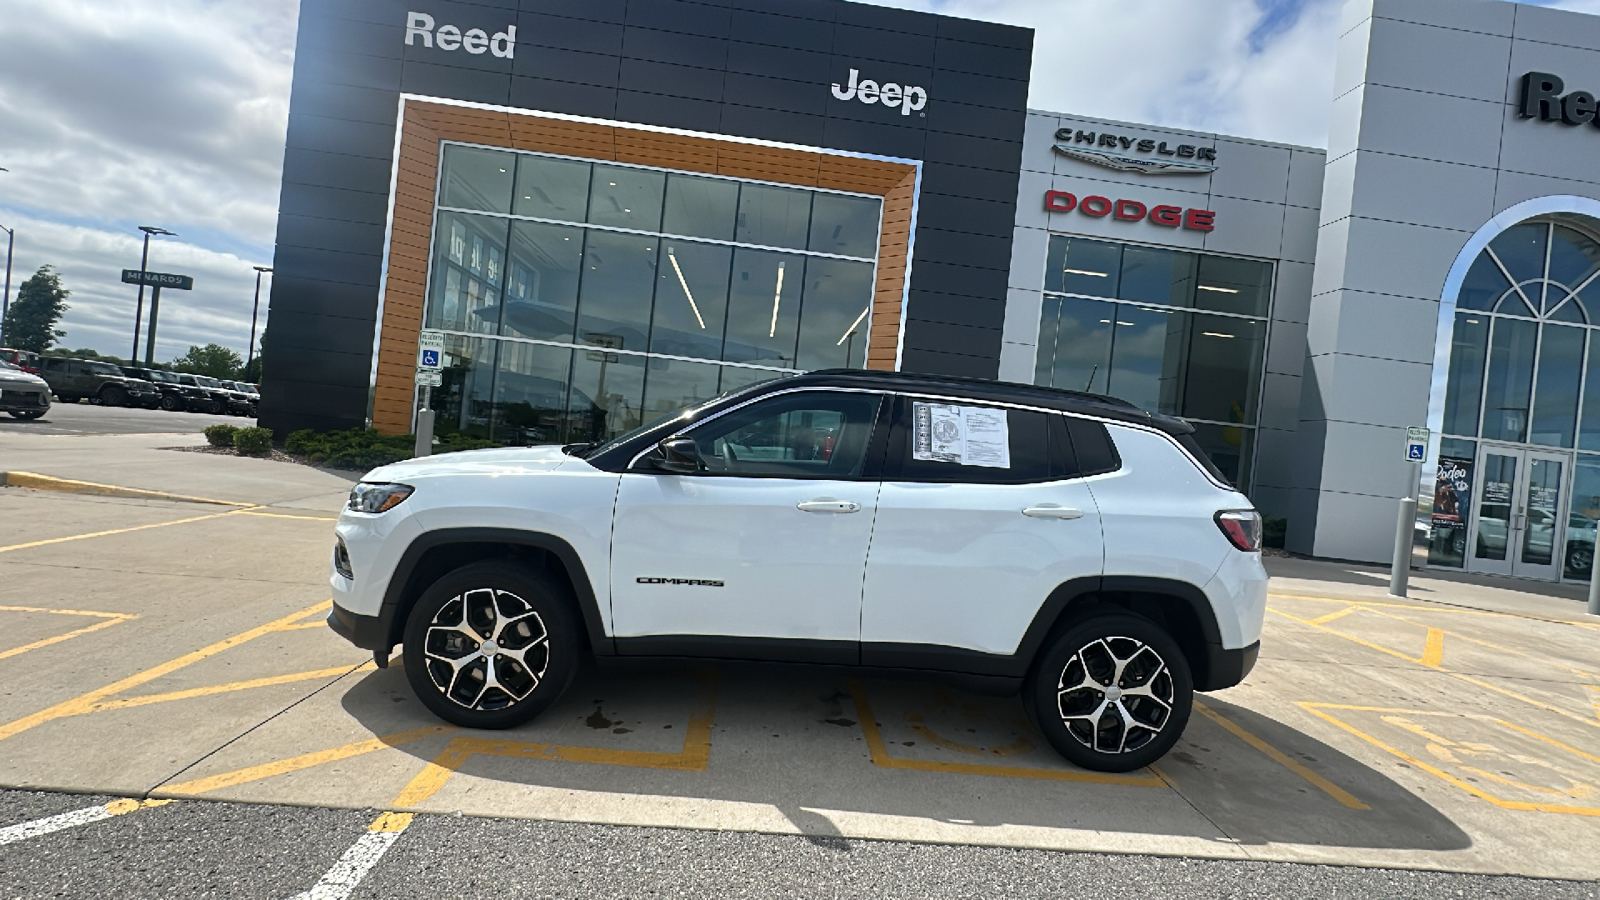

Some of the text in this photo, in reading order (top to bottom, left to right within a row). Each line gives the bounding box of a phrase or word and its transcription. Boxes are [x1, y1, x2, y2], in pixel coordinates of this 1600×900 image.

[404, 11, 516, 59] Reed
[831, 68, 928, 116] Jeep
[1520, 71, 1600, 127] Re
[1055, 128, 1217, 161] CHRYSLER
[1045, 189, 1216, 231] DODGE
[636, 577, 725, 588] COMPASS
